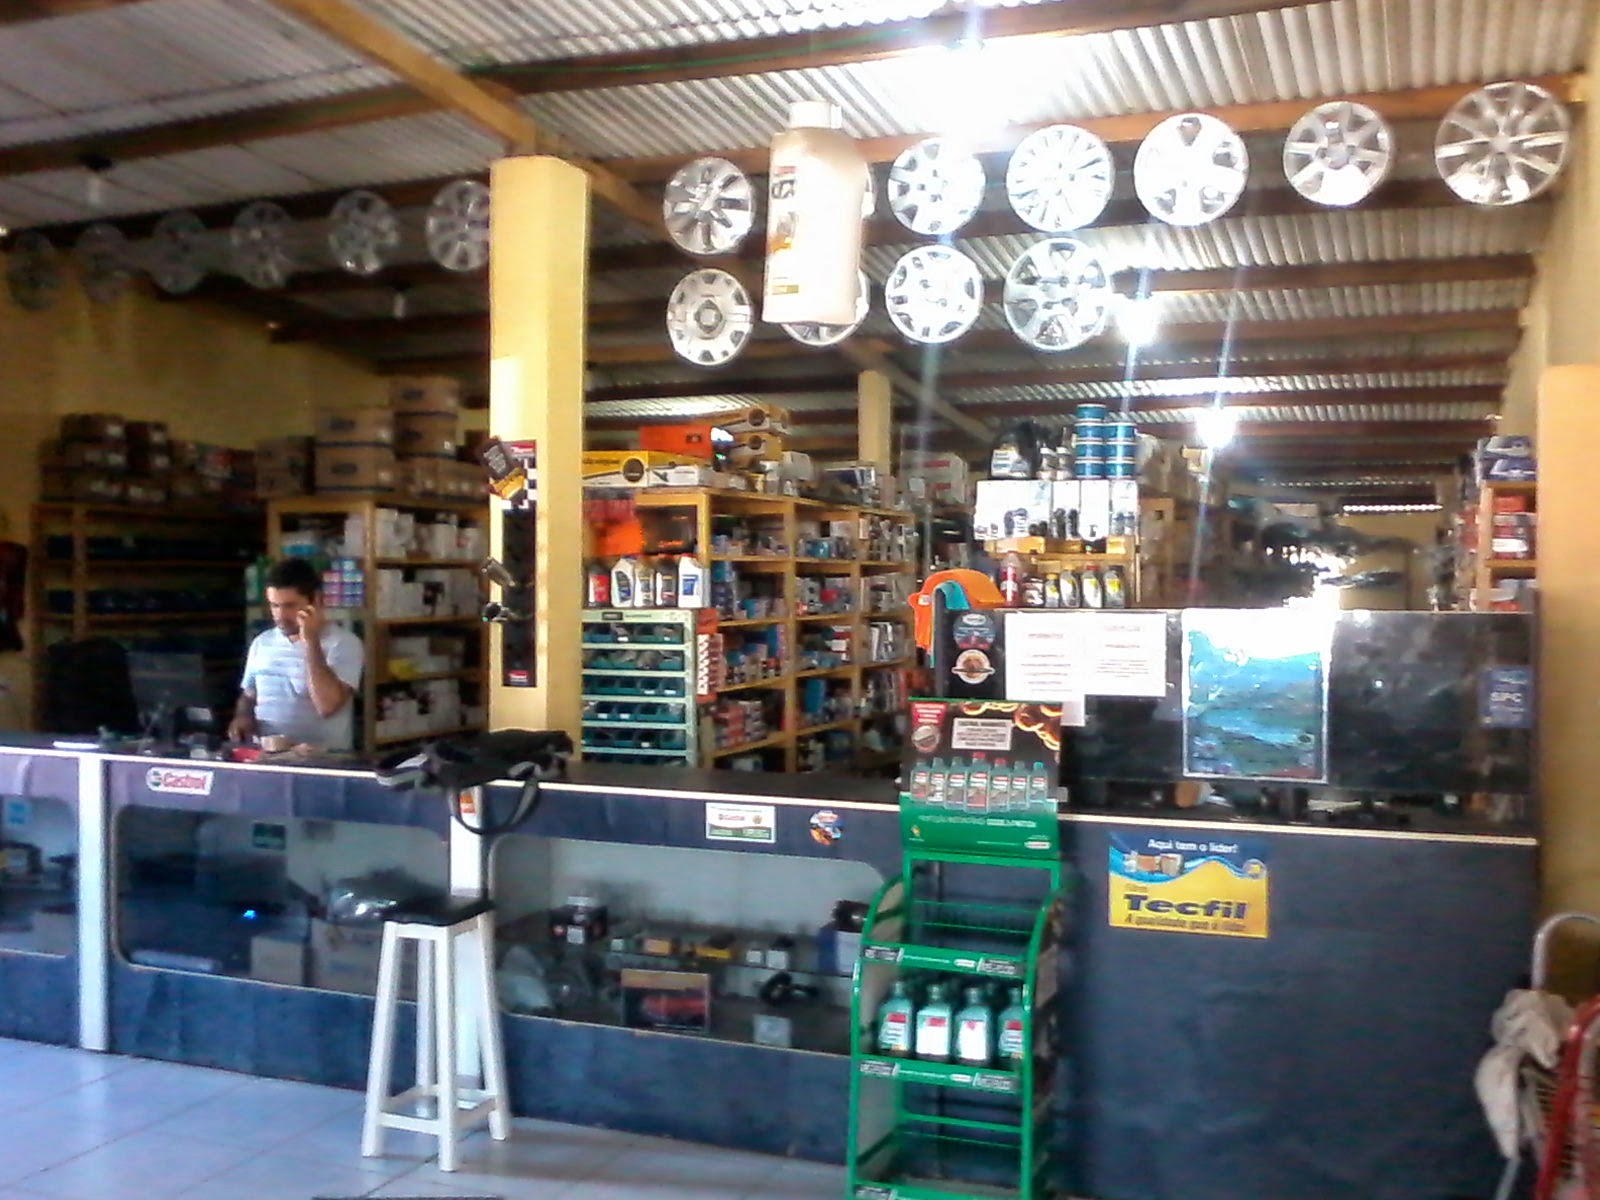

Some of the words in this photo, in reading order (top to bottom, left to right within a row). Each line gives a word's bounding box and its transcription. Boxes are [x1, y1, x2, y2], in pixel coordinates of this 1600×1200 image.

[163, 771, 207, 790] Castrol
[1147, 838, 1173, 851] Aqui
[1175, 841, 1197, 851] tem
[1199, 843, 1208, 852] o
[1123, 892, 1248, 920] Tecfil
